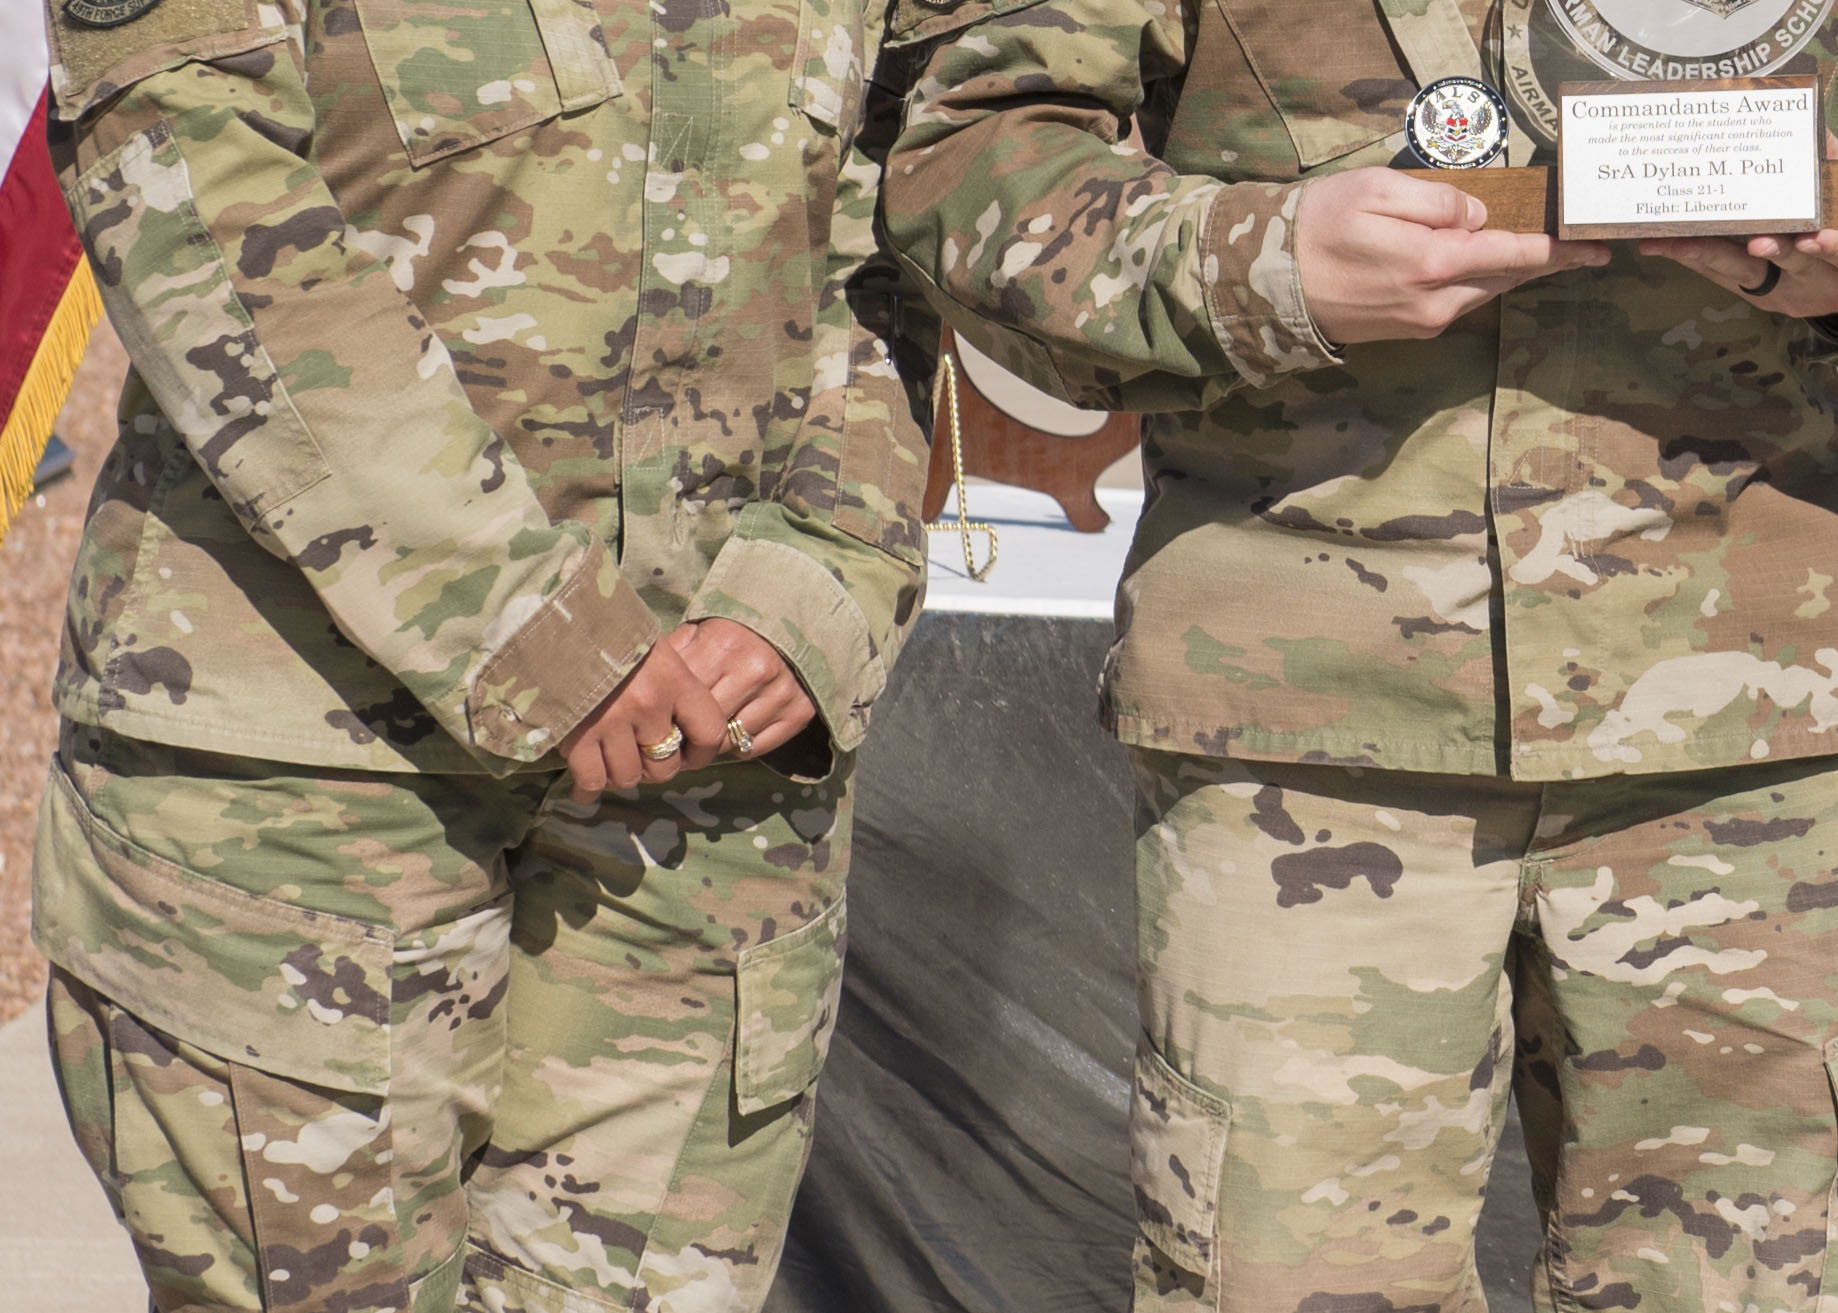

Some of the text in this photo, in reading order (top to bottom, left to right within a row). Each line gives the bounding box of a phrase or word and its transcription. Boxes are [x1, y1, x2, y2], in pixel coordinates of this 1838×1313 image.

[94, 5, 126, 20] FORCE
[1618, 42, 1772, 80] LEADERSHIP
[1435, 86, 1481, 104] ALS
[1572, 93, 1809, 119] Commandants Award
[1609, 116, 1773, 132] is presented to the student who
[1588, 129, 1793, 145] made the most significant contribution
[1618, 147, 1629, 156] to
[1632, 146, 1648, 155] the
[1650, 146, 1689, 155] success
[1691, 144, 1704, 157] of
[1705, 143, 1730, 153] their
[1597, 158, 1785, 182] SrA Dylan M. Pohl
[1656, 183, 1725, 197] Class 21-1
[1635, 200, 1748, 216] Flight: Liberator
